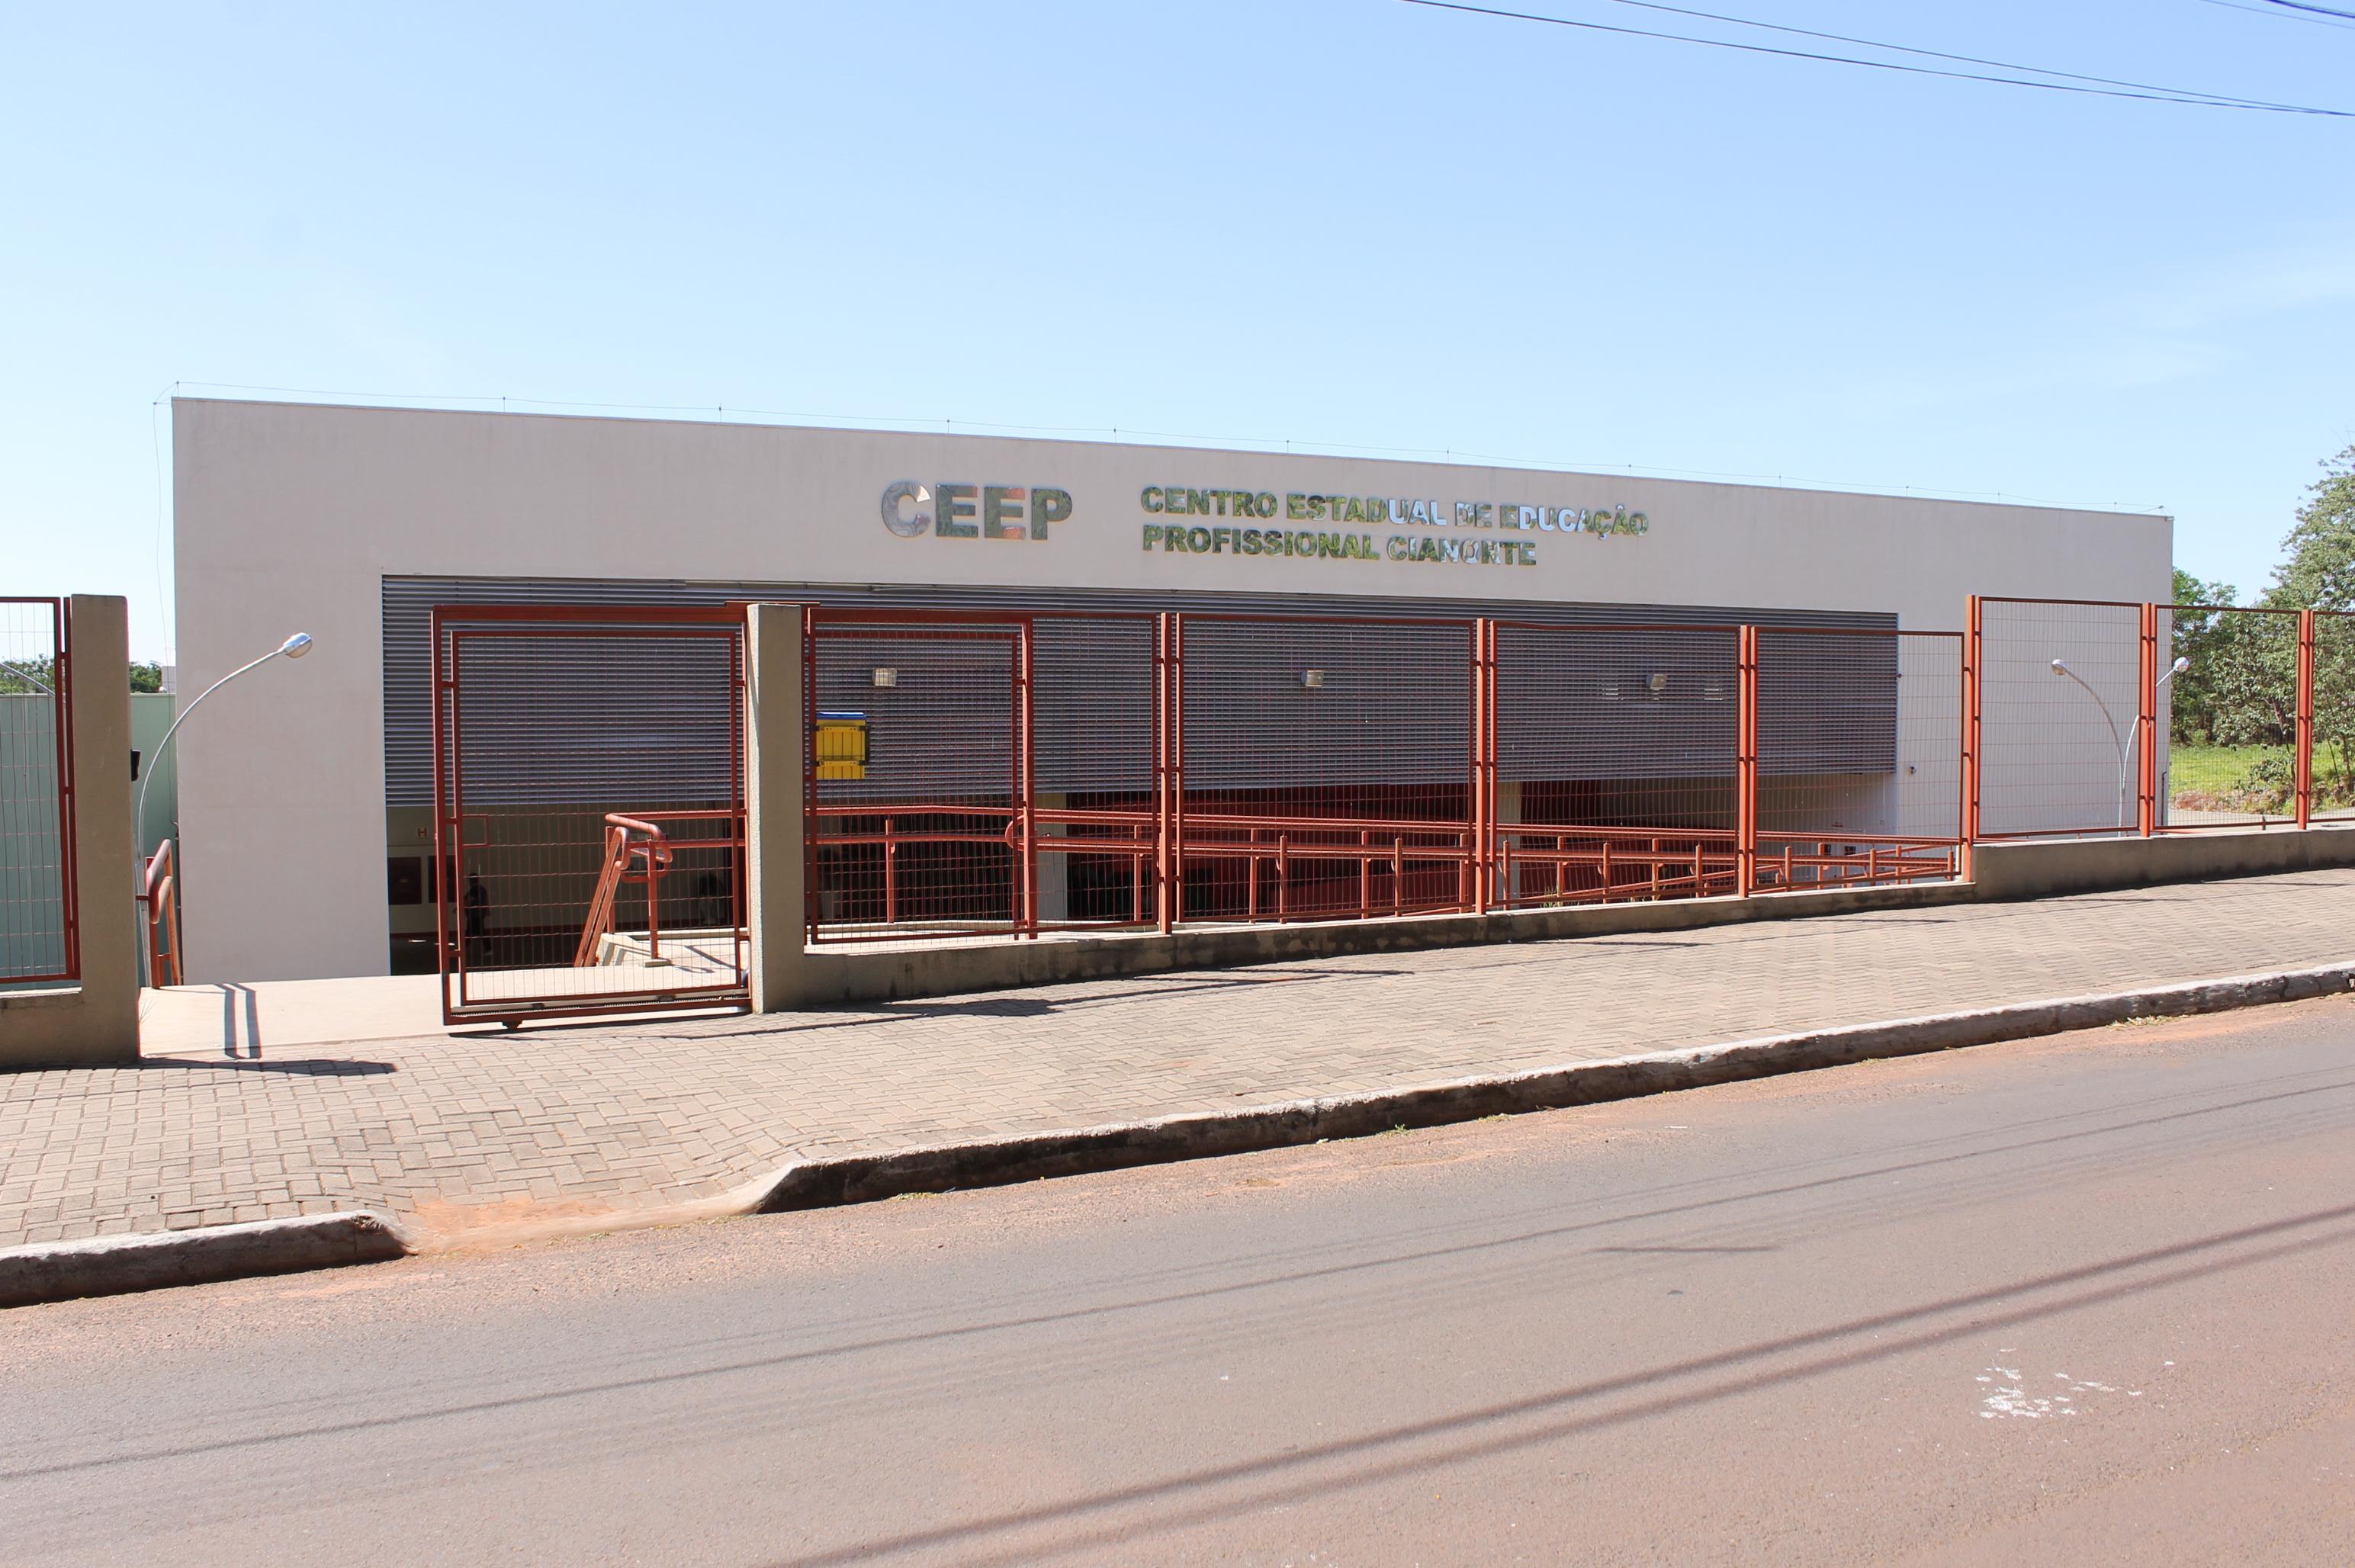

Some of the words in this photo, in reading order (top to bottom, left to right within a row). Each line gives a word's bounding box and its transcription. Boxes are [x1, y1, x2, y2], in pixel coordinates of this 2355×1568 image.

[881, 480, 1073, 540] CEEP
[1141, 487, 1278, 519] CENTRO
[1287, 493, 1447, 526] ESTADUAL
[1455, 503, 1492, 529] DE
[1499, 504, 1650, 541] EDUCAÇÃO
[1142, 524, 1380, 561] PROFISSIONAL
[1386, 535, 1537, 567] CIANORTE
[417, 827, 427, 837] H
